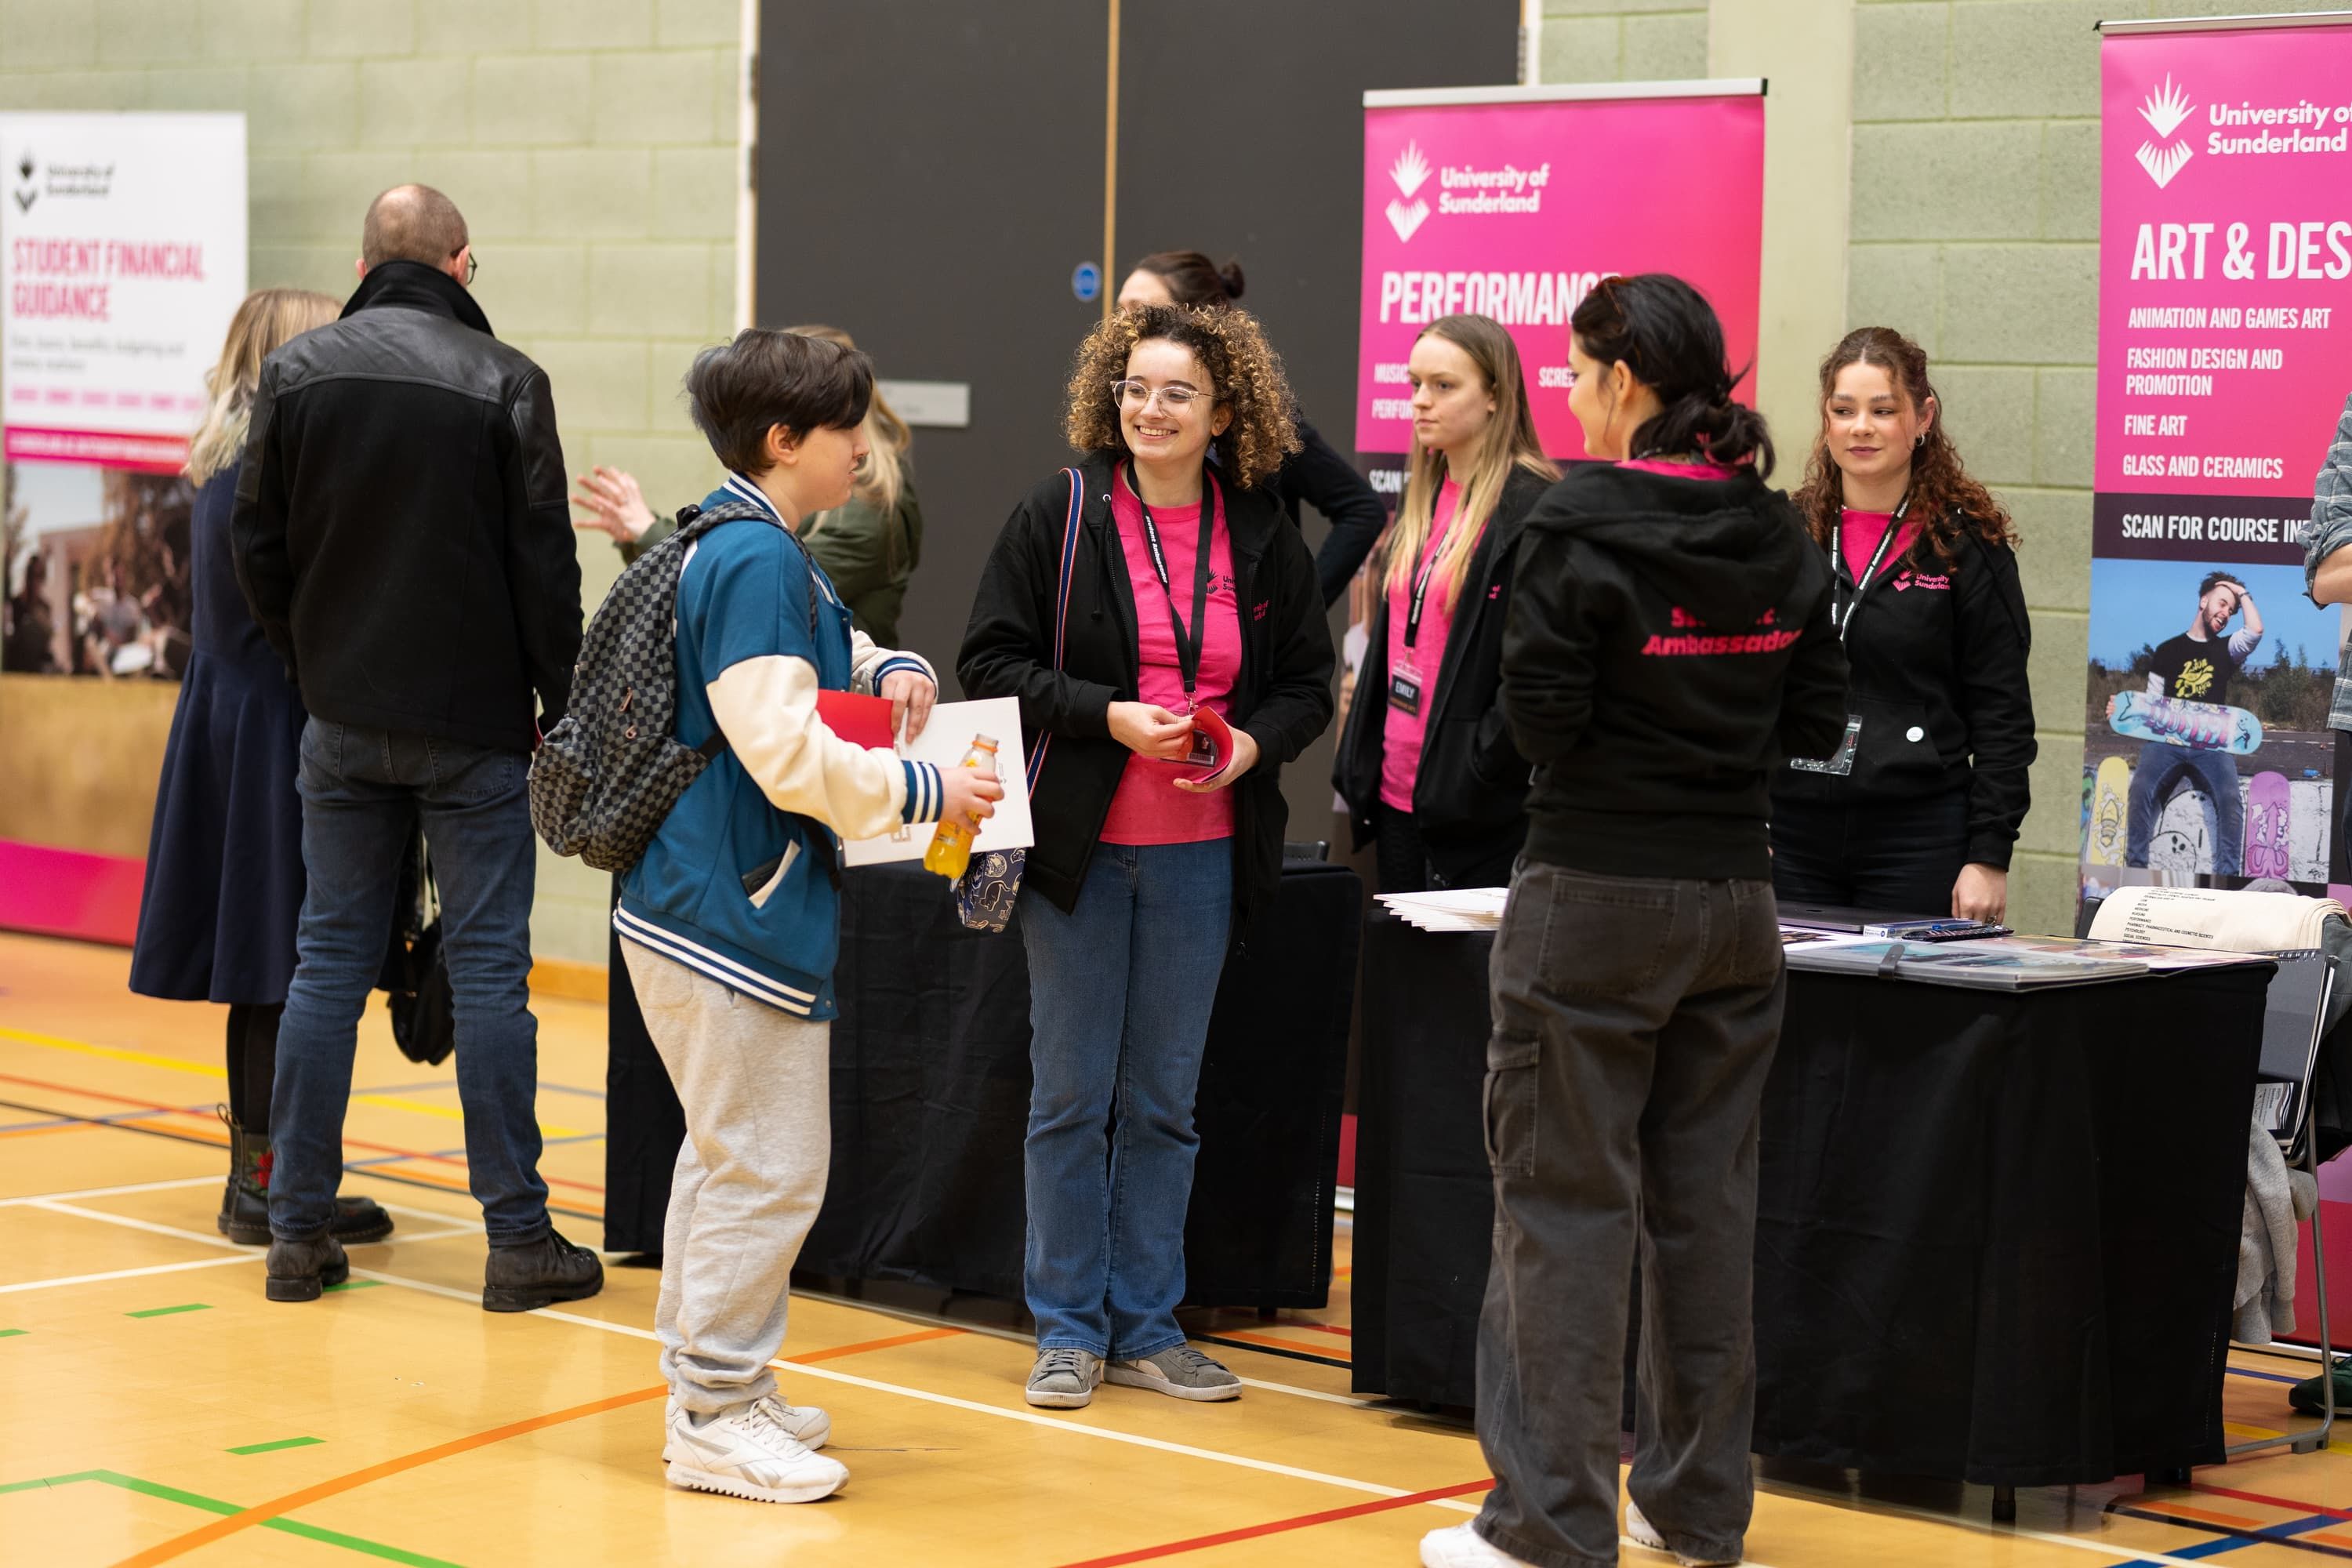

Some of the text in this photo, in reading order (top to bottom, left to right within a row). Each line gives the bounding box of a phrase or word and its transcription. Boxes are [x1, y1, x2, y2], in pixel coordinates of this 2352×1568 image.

[2209, 100, 2330, 130] University
[2207, 127, 2347, 155] Sunderland
[1440, 163, 1550, 191] University of
[1439, 191, 1541, 214] Sunderland
[13, 237, 206, 281] STUDENT FINANCIAL
[2130, 221, 2352, 280] ART & DES
[13, 282, 110, 321] GUIDANCE
[1380, 271, 1621, 325] PERFORMANC
[2128, 307, 2332, 329] ANIMATION AND GAMES ART
[2127, 348, 2283, 370] FASHION DESIGN AND
[2126, 375, 2212, 396] PROMOTION
[2124, 415, 2187, 436] FINE ART
[2122, 455, 2283, 480] GLASS AND CERAMICS
[1369, 470, 1402, 493] SCAN
[2122, 514, 2311, 543] SCAN FOR COURSE IN
[1395, 681, 1415, 699] EMILY
